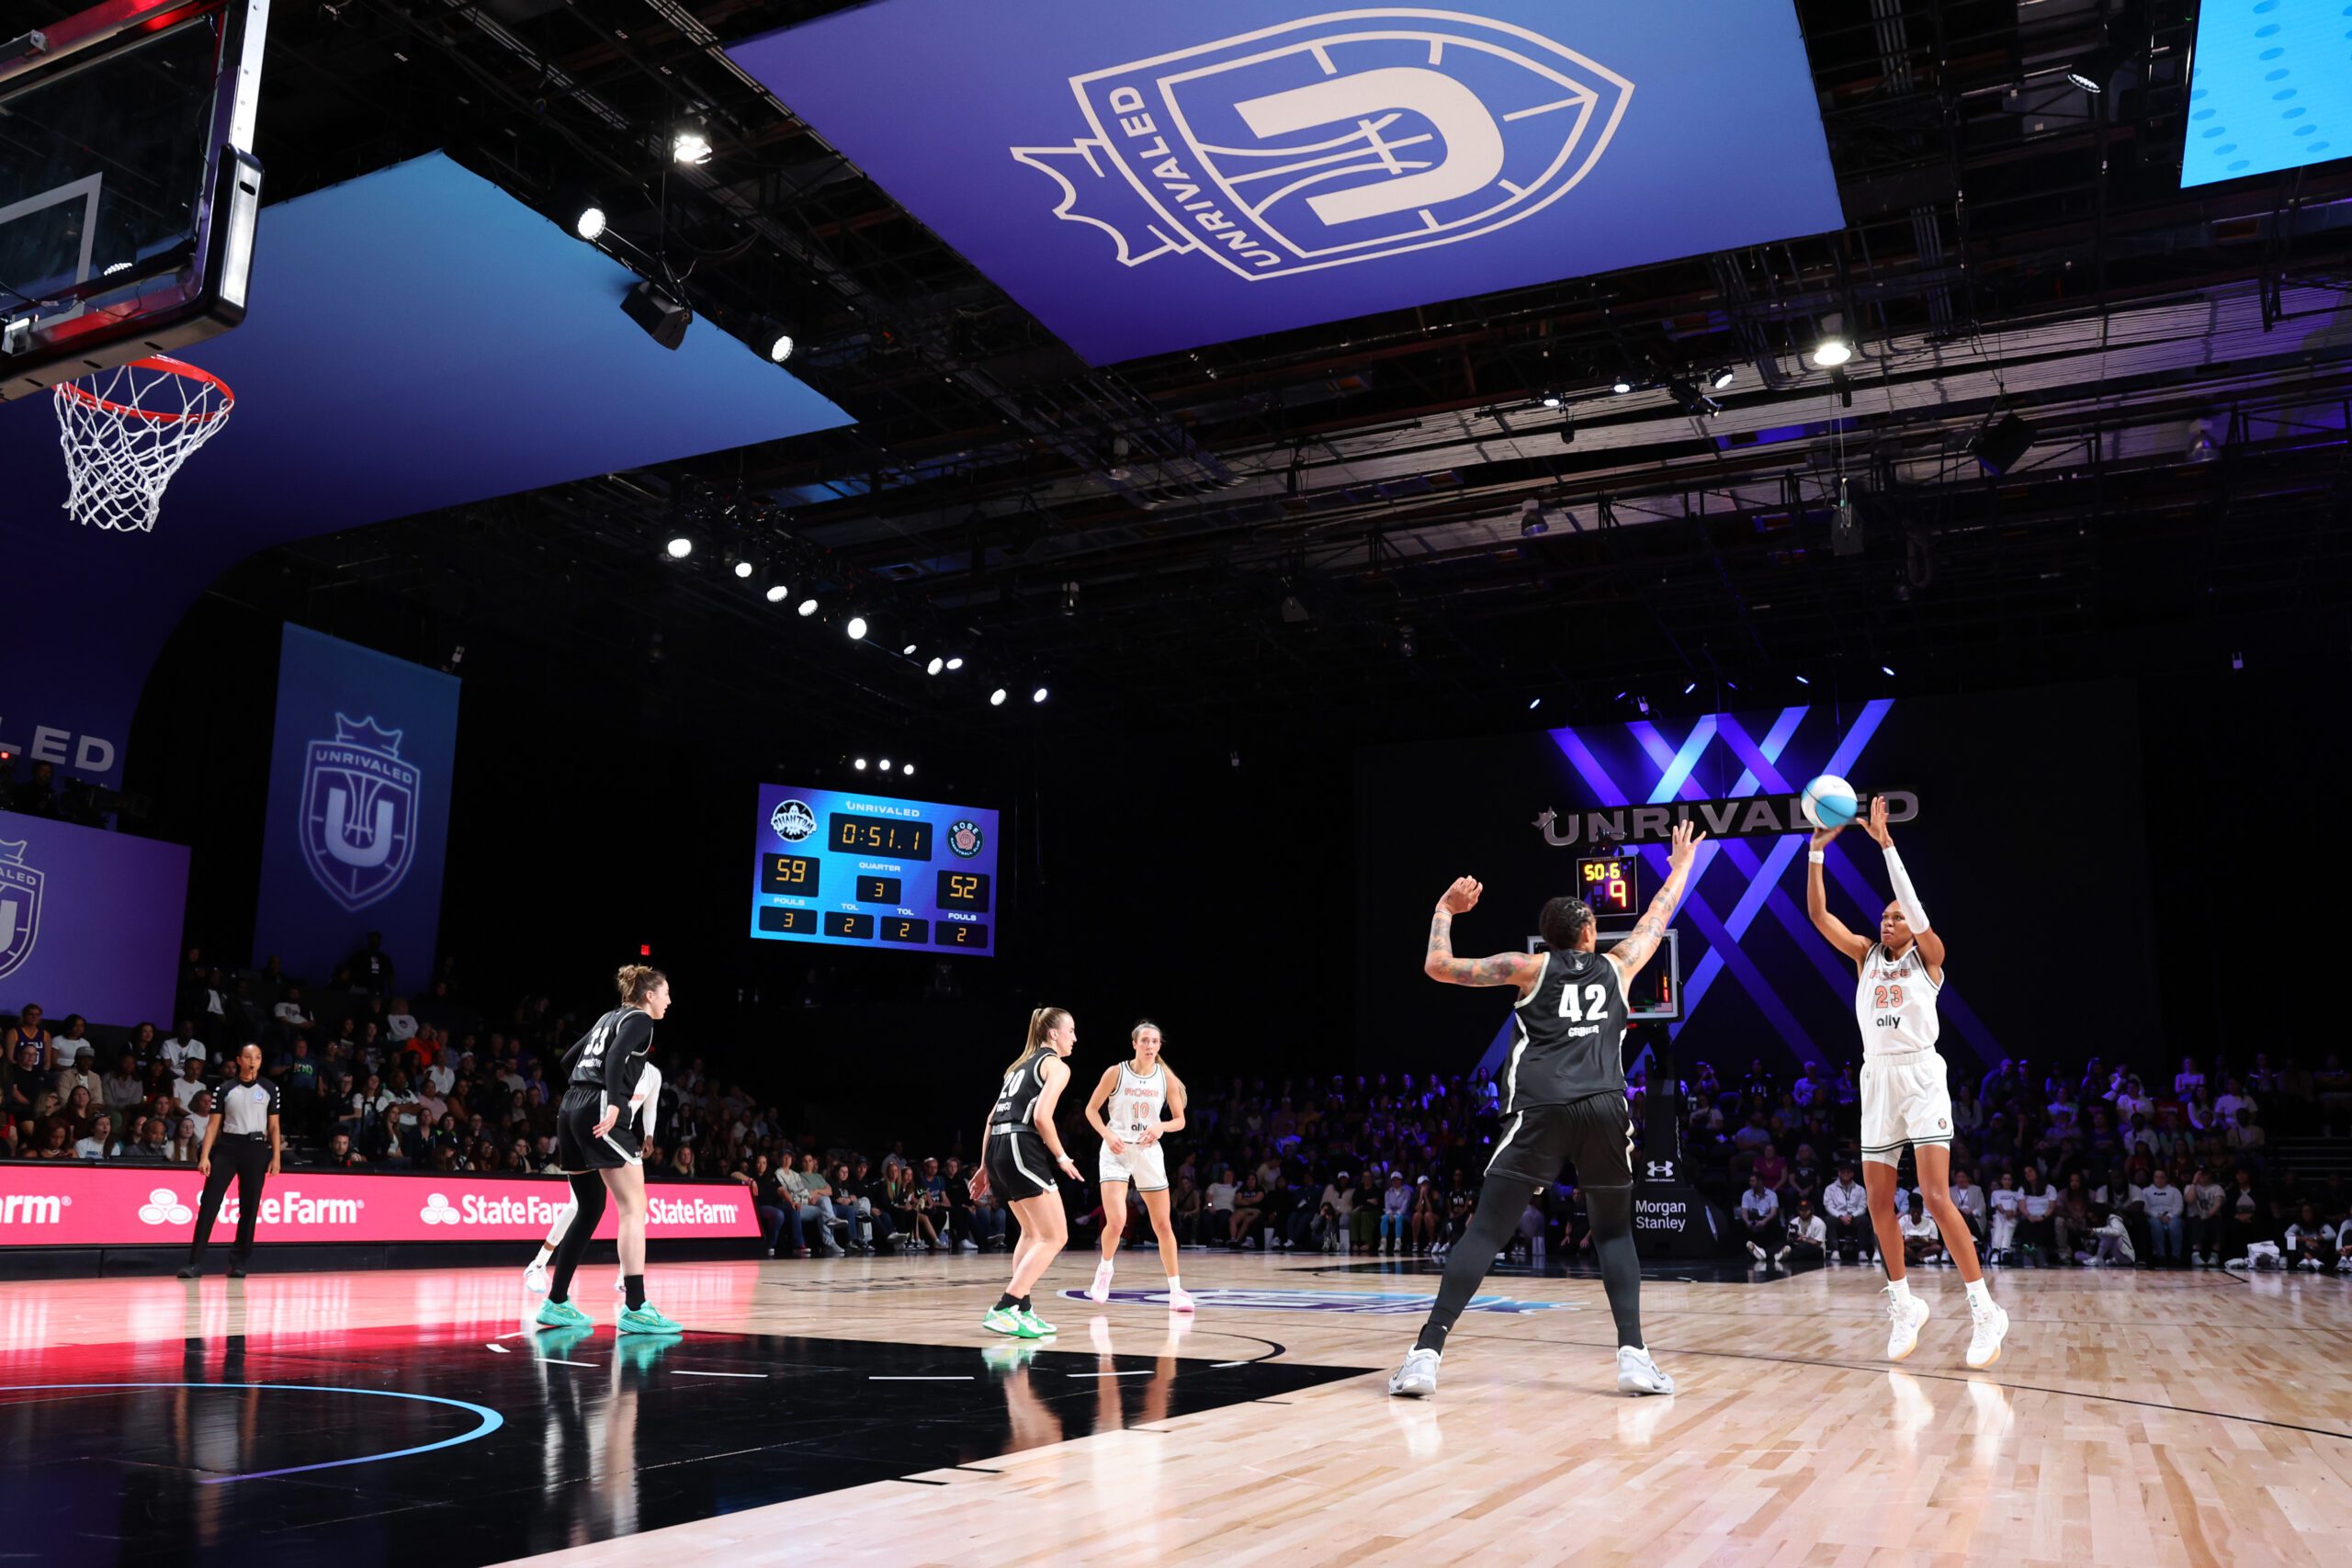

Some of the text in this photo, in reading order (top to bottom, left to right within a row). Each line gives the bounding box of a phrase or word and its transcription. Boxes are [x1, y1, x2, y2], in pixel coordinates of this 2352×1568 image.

[1109, 85, 1282, 269] UNRIVALED
[315, 750, 413, 785] UNRIVALED
[845, 801, 920, 818] UNRIVALED
[324, 787, 394, 867] U
[773, 814, 814, 831] PHANTOM
[952, 821, 979, 835] ROSE
[775, 858, 807, 883] 59
[858, 862, 900, 873] QUARTER
[875, 883, 885, 897] 3
[949, 875, 978, 899] 52
[1610, 880, 1627, 908] 9
[774, 897, 805, 907] FOULS
[842, 903, 859, 911] TOL
[783, 913, 794, 928] 3
[897, 908, 914, 917] TOL
[948, 912, 977, 921] FOULS
[843, 918, 854, 932] 2
[899, 922, 910, 938] 2
[956, 928, 967, 942] 2
[1558, 983, 1609, 1023] 42
[1874, 985, 1904, 1009] 23
[1876, 1015, 1901, 1029] ally
[583, 1026, 609, 1056] 33
[999, 1069, 1026, 1100] 20
[1132, 1101, 1149, 1119] 10
[1635, 1200, 1686, 1216] Morgan
[1635, 1216, 1686, 1233] Stanley
